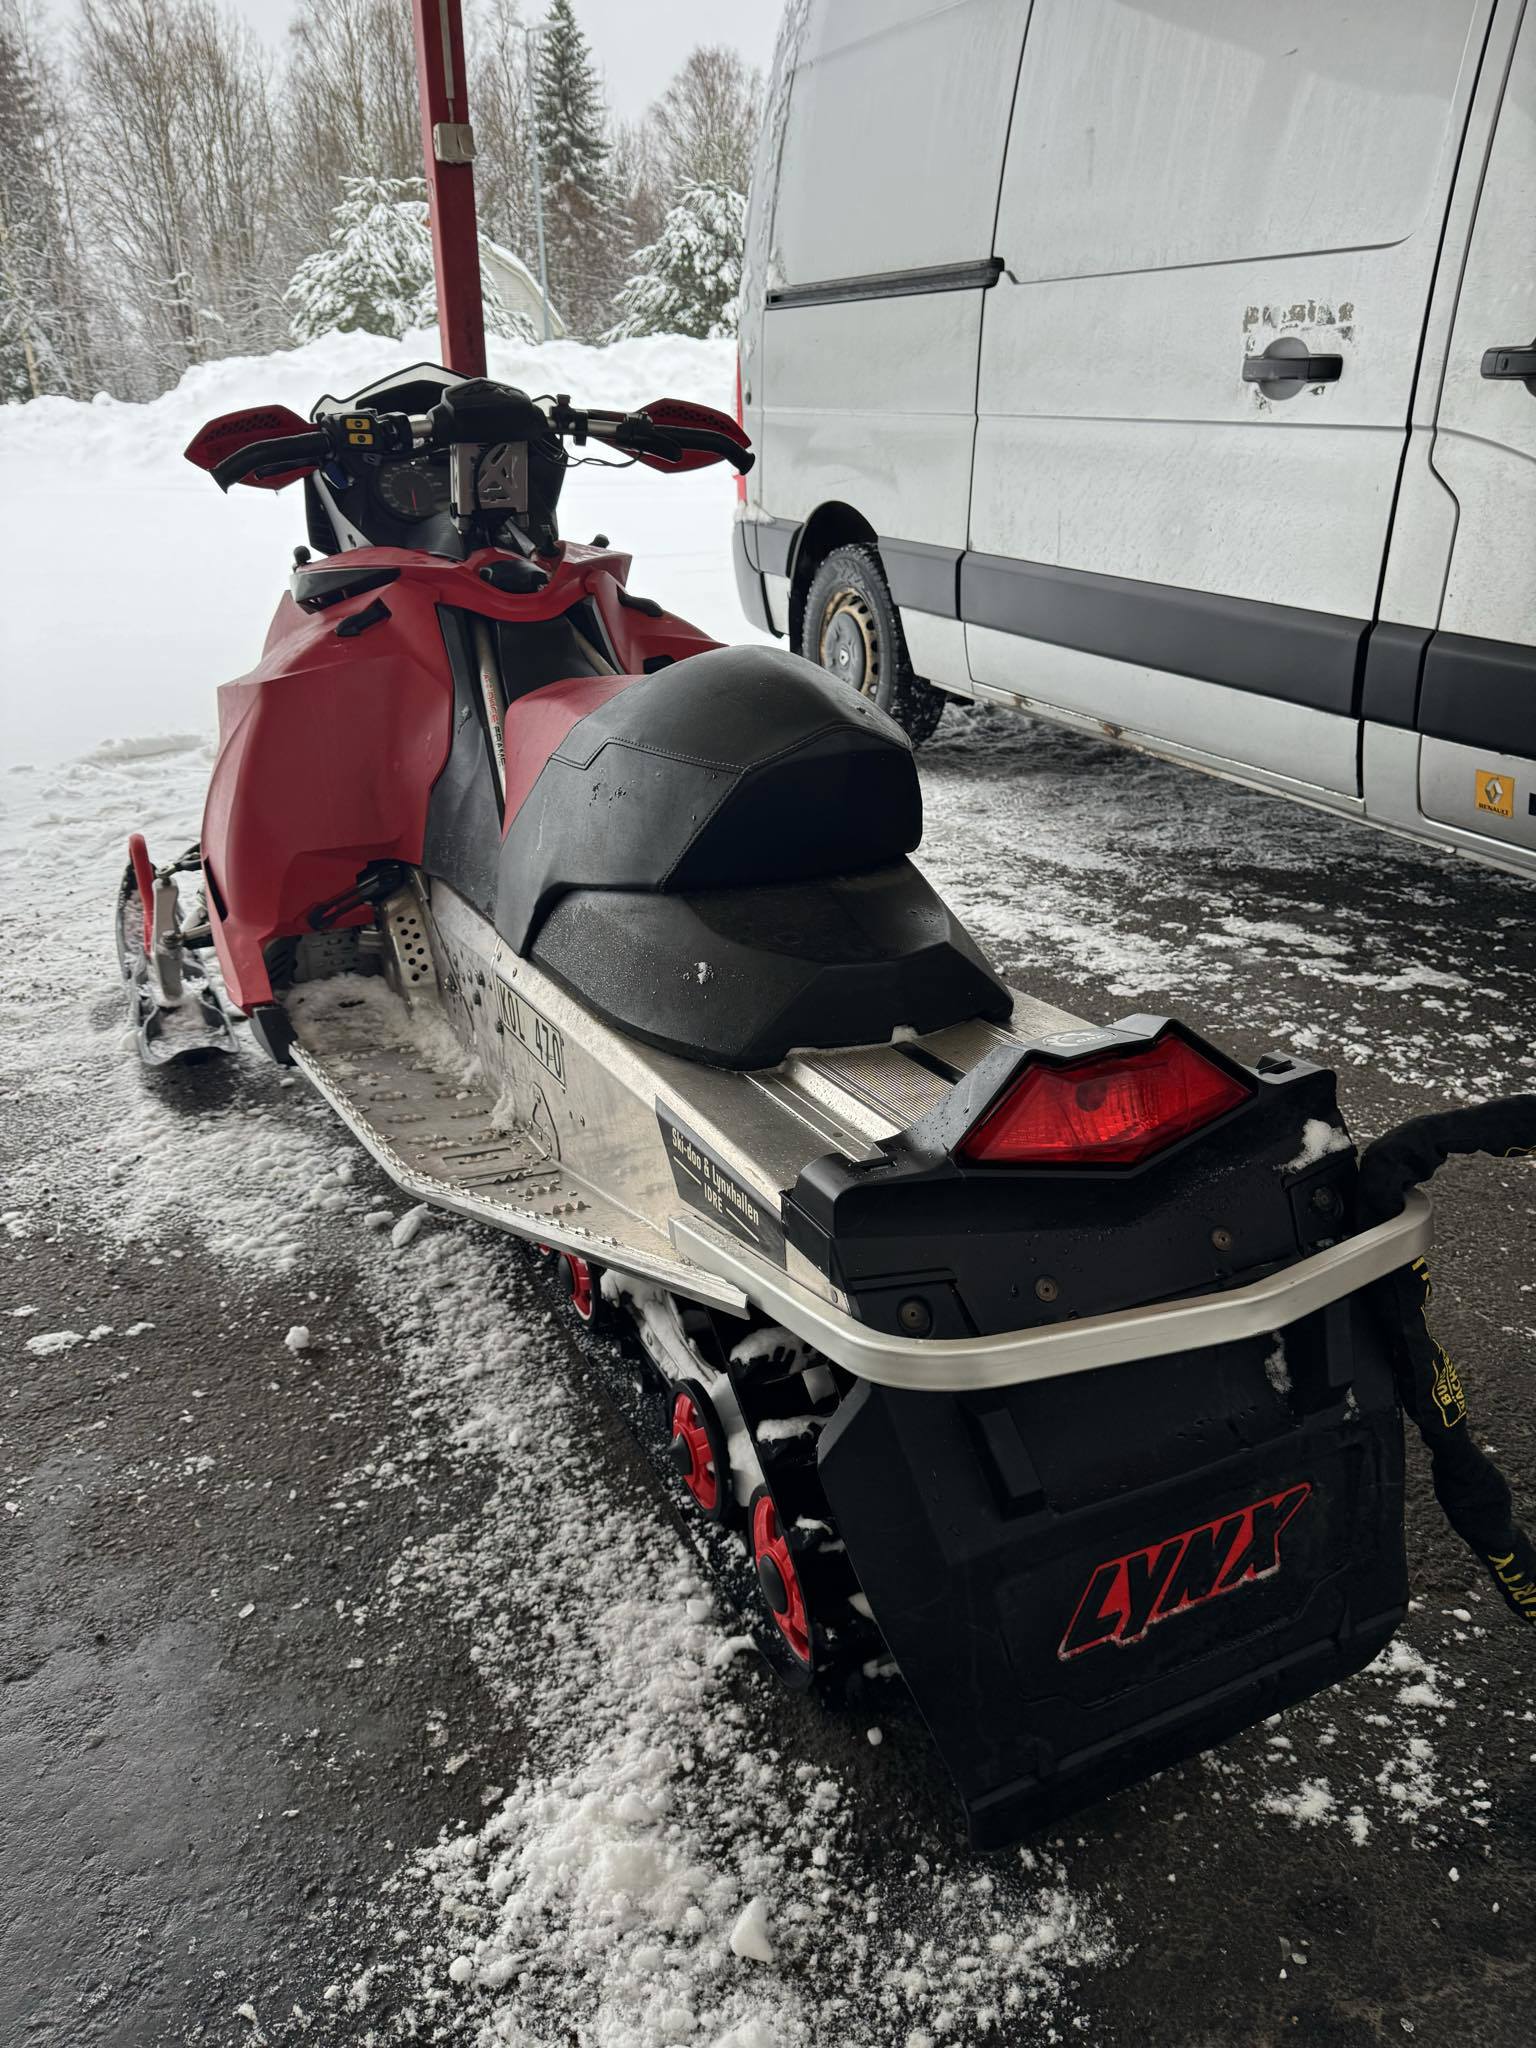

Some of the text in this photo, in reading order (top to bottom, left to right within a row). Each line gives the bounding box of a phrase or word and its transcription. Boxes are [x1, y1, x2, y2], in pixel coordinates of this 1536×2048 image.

[1478, 801, 1509, 816] RENAULT
[499, 981, 562, 1079] KOL 470
[671, 1127, 760, 1226] Ski-doo & Lynxhallen
[703, 1182, 724, 1214] IDRE
[1057, 1482, 1311, 1661] LYNX
